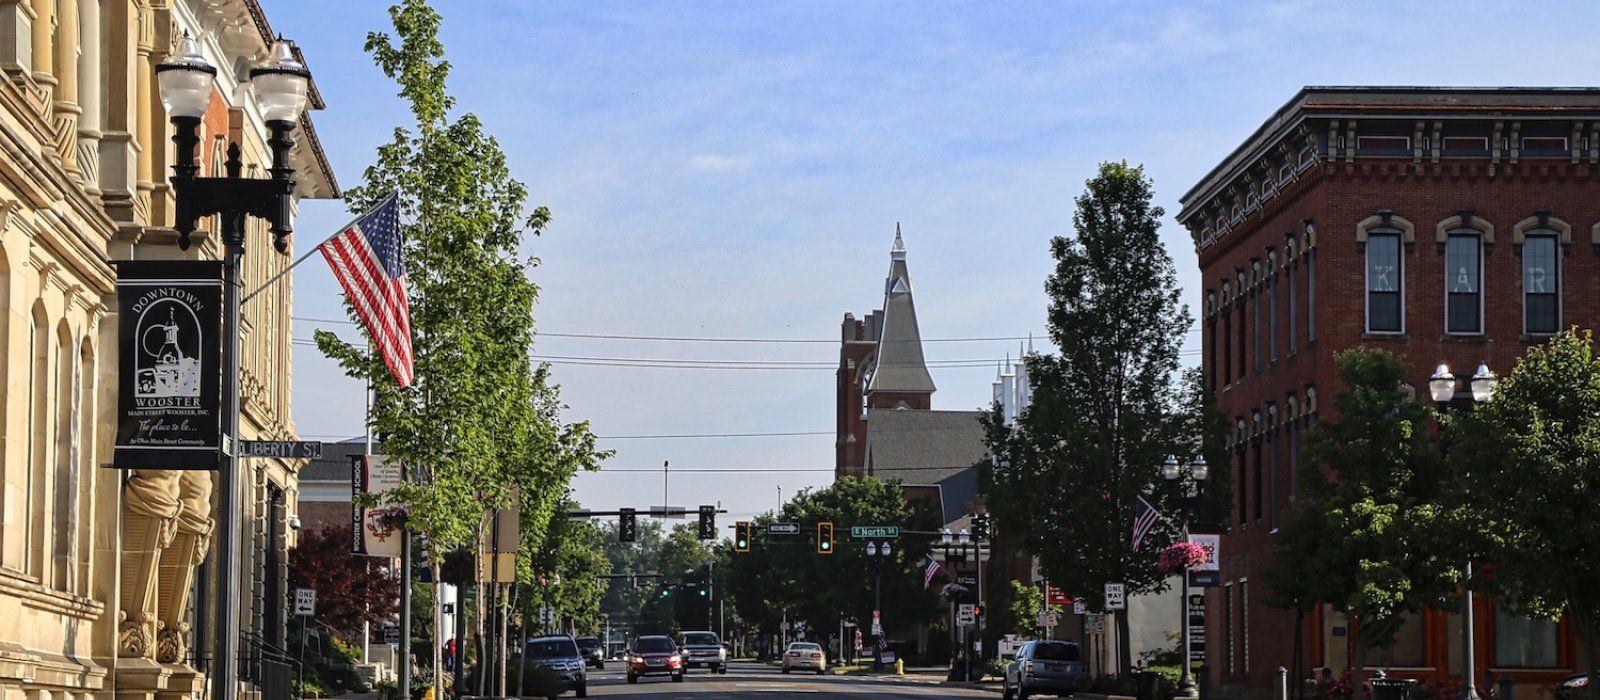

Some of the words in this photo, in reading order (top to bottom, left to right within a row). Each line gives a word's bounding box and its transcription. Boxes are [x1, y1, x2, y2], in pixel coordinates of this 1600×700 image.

[132, 287, 205, 315] DOWNTOWN
[136, 397, 201, 407] WOOSTER
[138, 419, 151, 431] The
[148, 419, 171, 437] place
[171, 423, 179, 432] to
[178, 438, 205, 446] Community
[240, 441, 297, 457] LIBERTY
[302, 442, 320, 457] ST.
[862, 528, 886, 536] North
